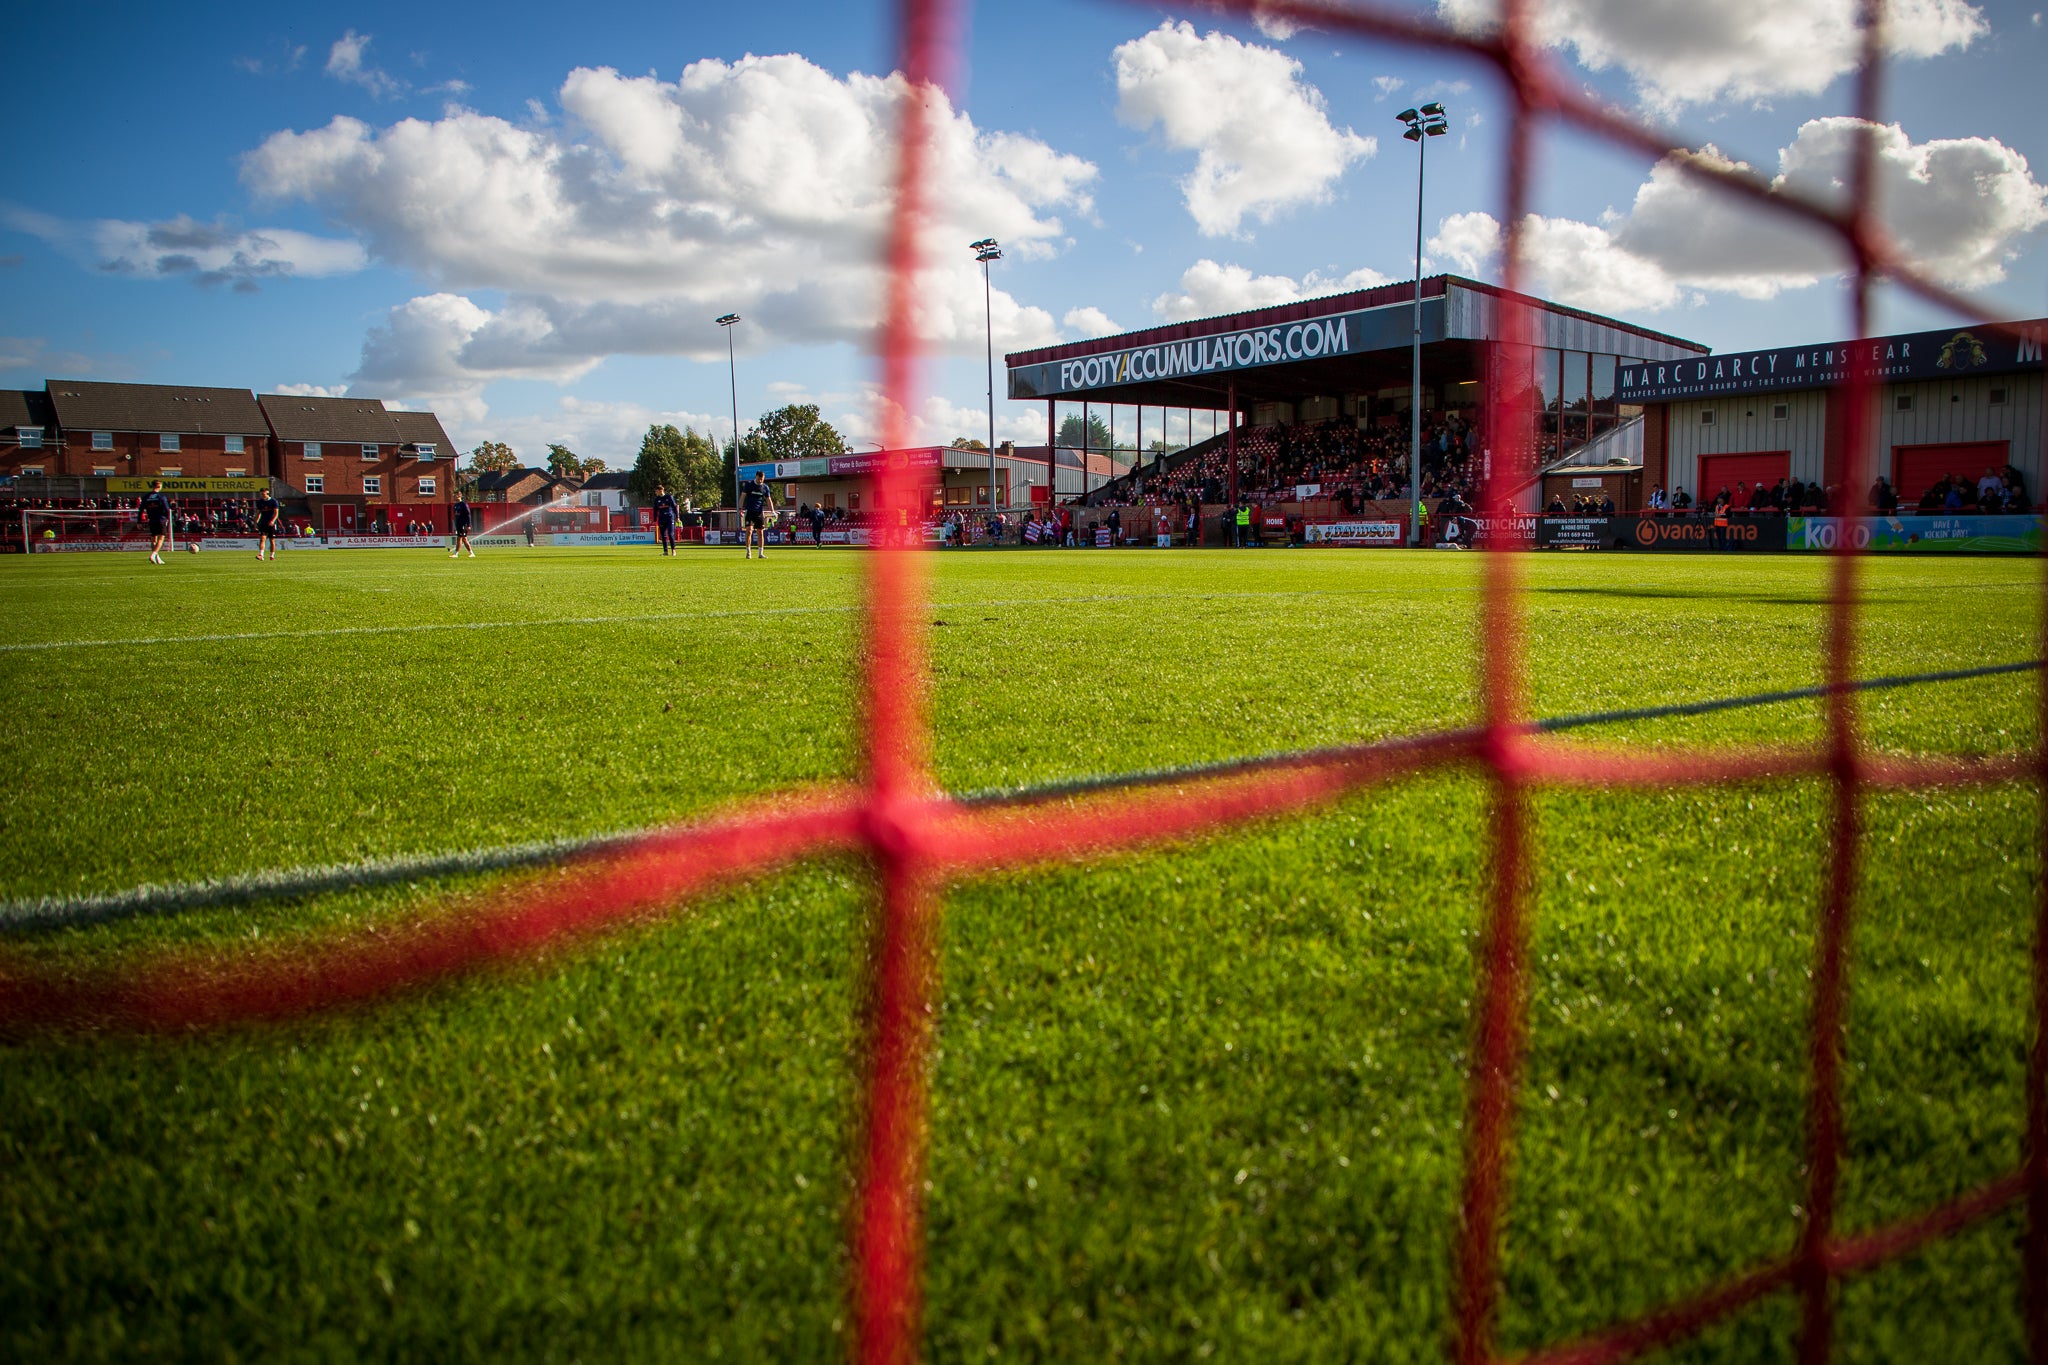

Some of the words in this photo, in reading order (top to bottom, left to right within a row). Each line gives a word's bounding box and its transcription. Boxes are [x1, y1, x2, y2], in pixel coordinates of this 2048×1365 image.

[1623, 364, 1682, 388] MARC
[1698, 354, 1778, 381] DARCY
[1795, 342, 1911, 368] MENSWEAR
[1622, 389, 1657, 399] DRAPERS
[1661, 385, 1705, 395] MENSWEAR
[1709, 382, 1737, 391] BRAND
[1743, 380, 1753, 388] OF
[1759, 378, 1774, 386] THE
[1780, 375, 1803, 384] YEAR
[1863, 365, 1911, 377] WINNERS
[851, 460, 855, 468] &
[855, 460, 871, 468] Business
[122, 481, 142, 489] THE
[146, 481, 206, 489] VNDITAN
[210, 481, 255, 489] TERRACE
[1932, 520, 1951, 529] HAVE
[1954, 520, 1960, 528] A
[1523, 531, 1536, 539] Ltd
[1952, 529, 1969, 538] DAY!
[580, 534, 618, 542] Altrincham's
